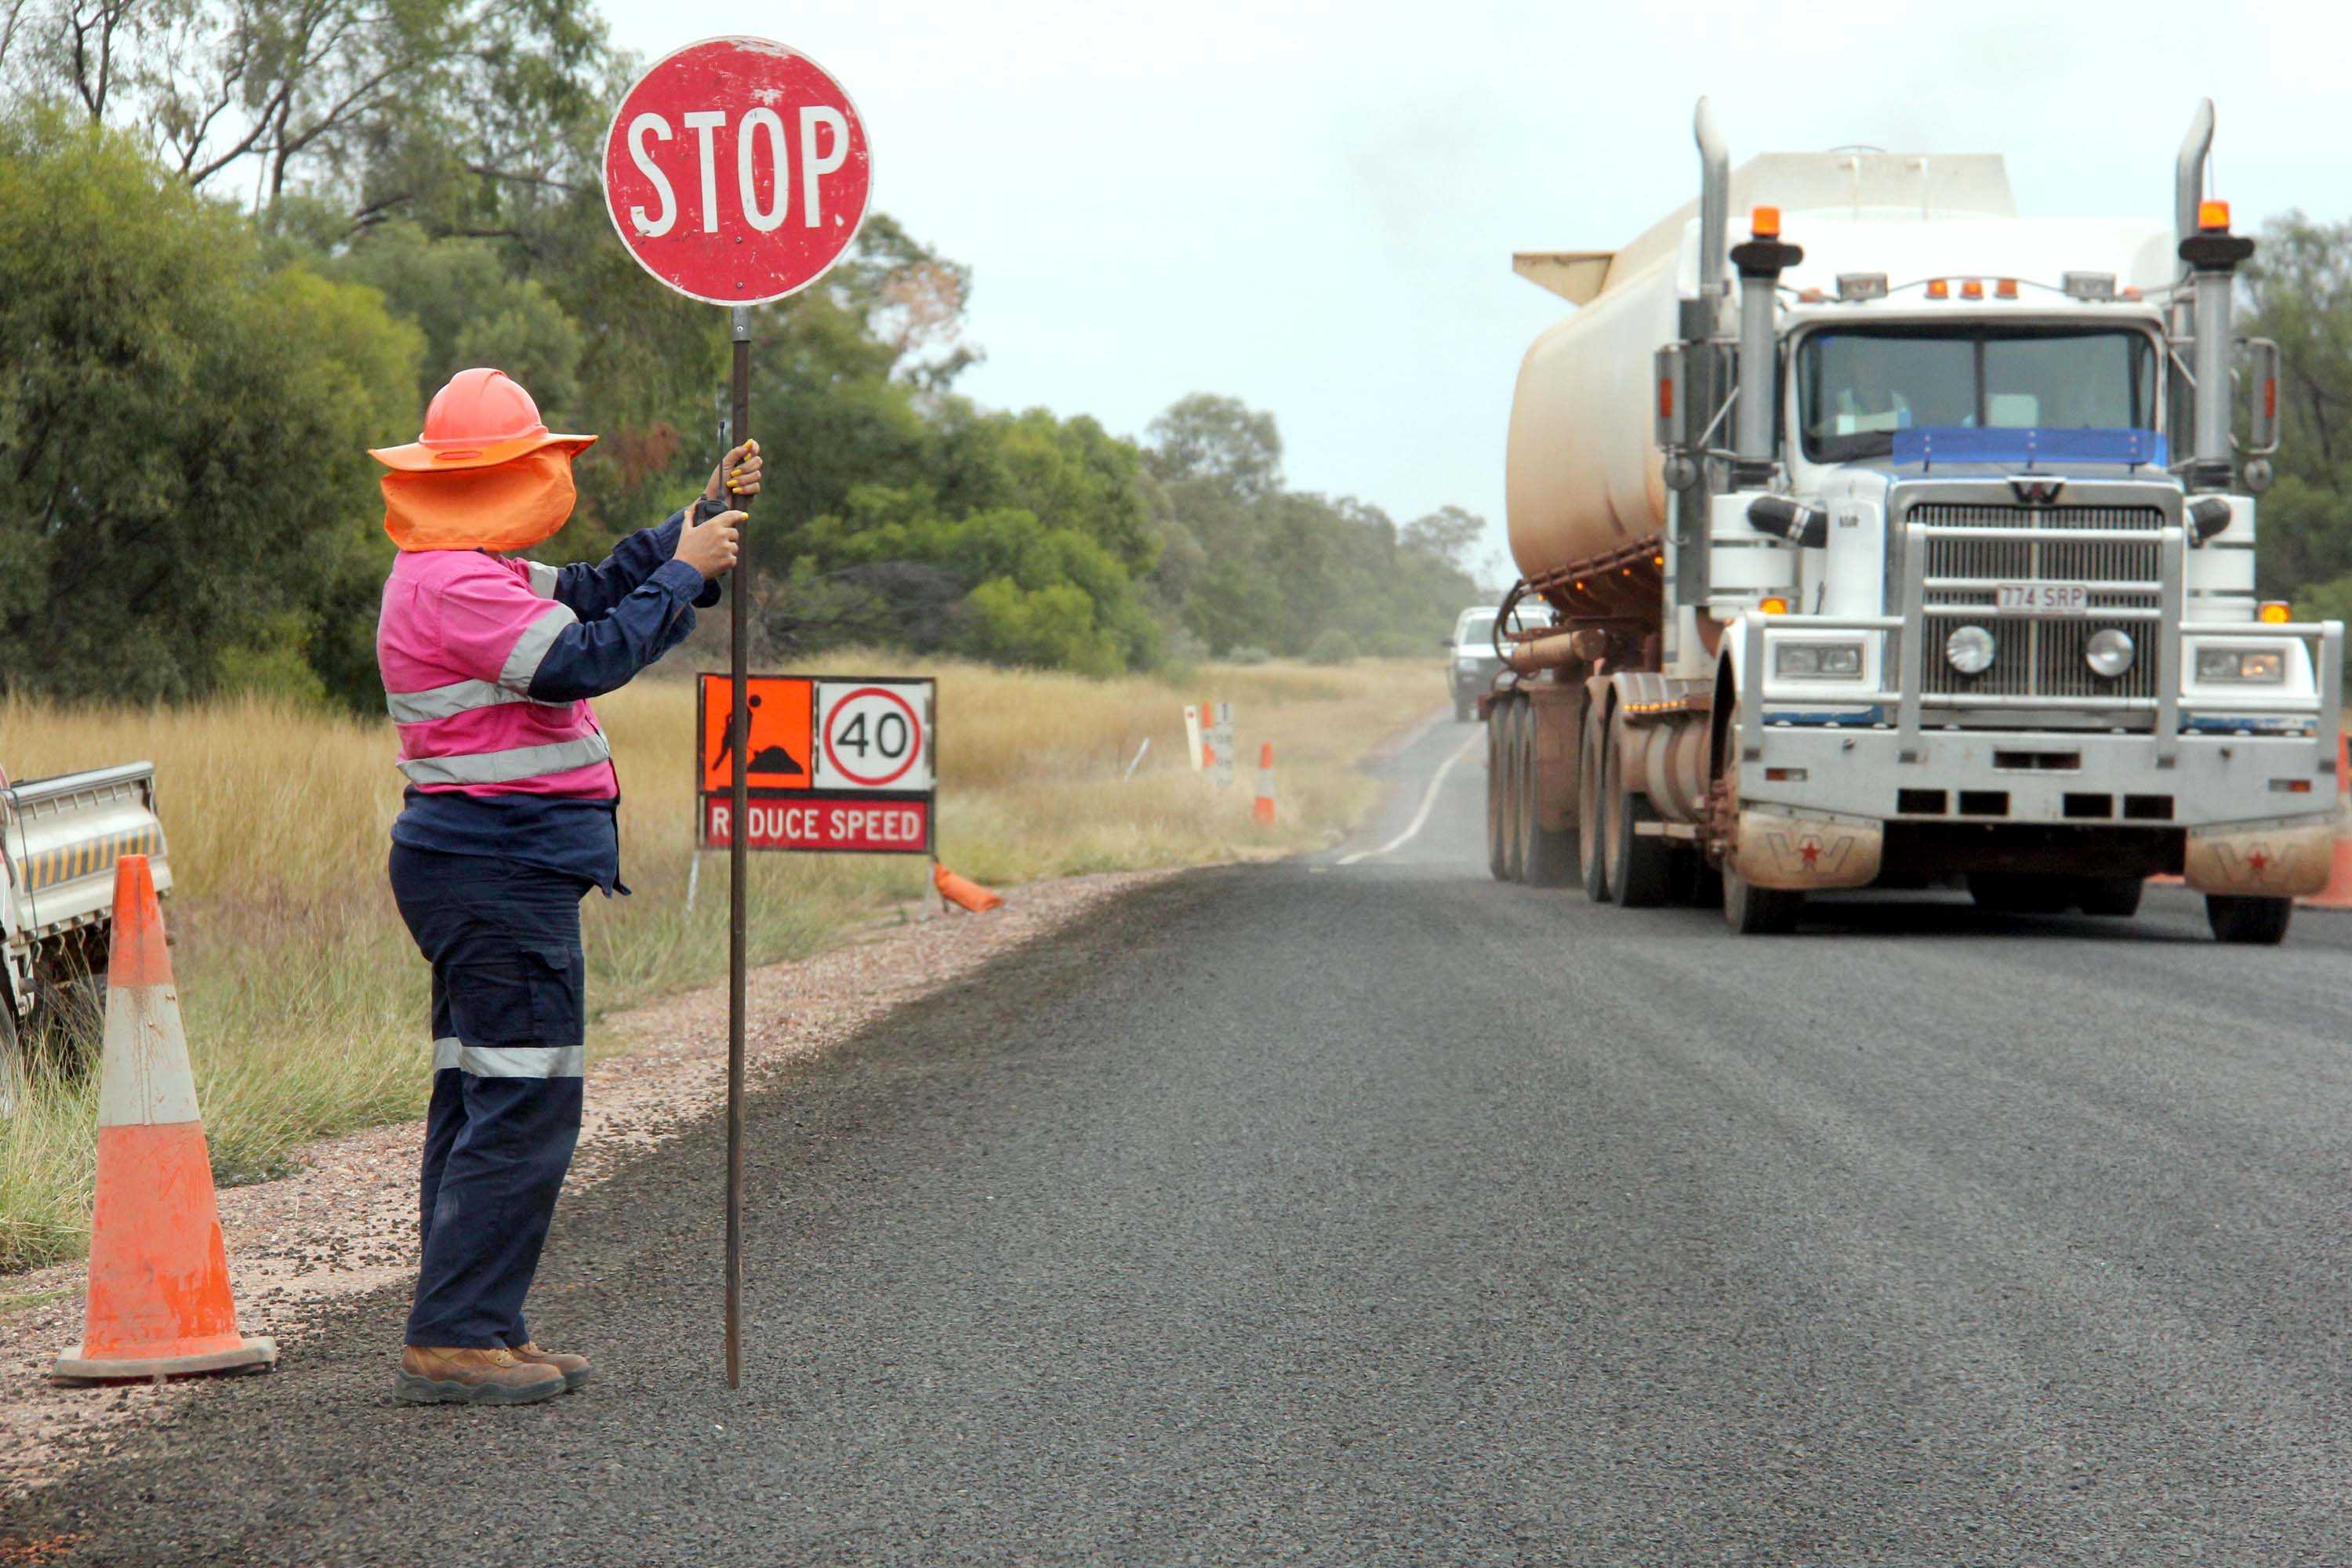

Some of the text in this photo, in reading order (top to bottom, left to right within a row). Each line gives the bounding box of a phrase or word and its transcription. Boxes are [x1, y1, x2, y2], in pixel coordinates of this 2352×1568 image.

[627, 105, 850, 238] STOP
[2044, 588, 2083, 606] SRP
[836, 711, 908, 758] 40
[712, 806, 920, 841] RDUCE SPEED
